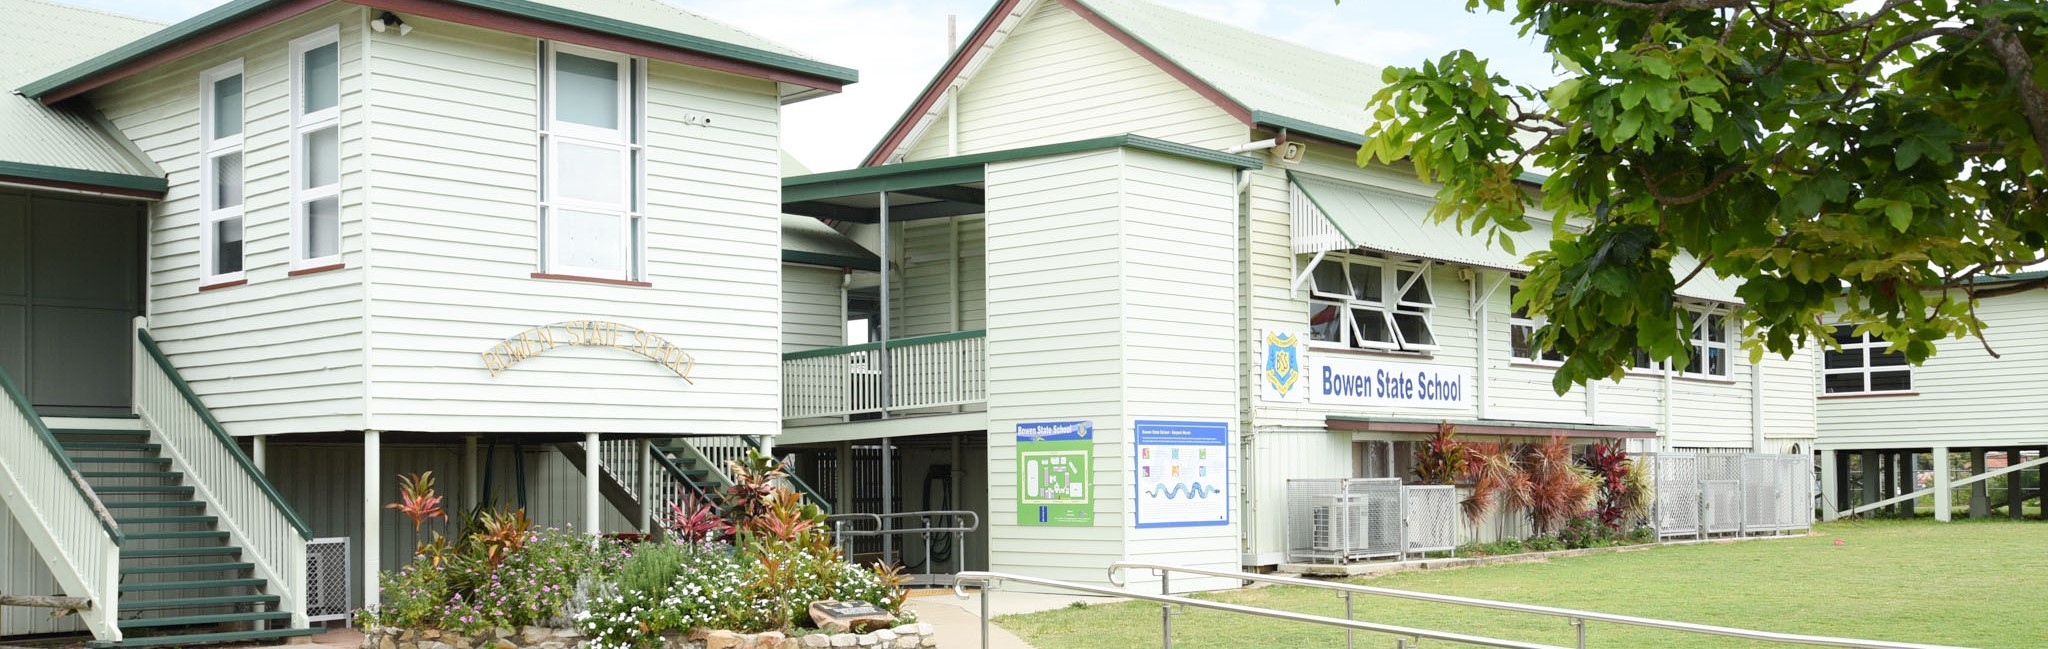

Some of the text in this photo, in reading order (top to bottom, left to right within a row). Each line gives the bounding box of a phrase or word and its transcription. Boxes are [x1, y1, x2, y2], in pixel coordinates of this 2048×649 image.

[481, 320, 695, 385] BOWEN STATE SCHOOL
[1322, 365, 1372, 397] Bowen
[1376, 368, 1413, 399] State
[1418, 371, 1461, 402] School
[1017, 424, 1072, 435] Bowen State School
